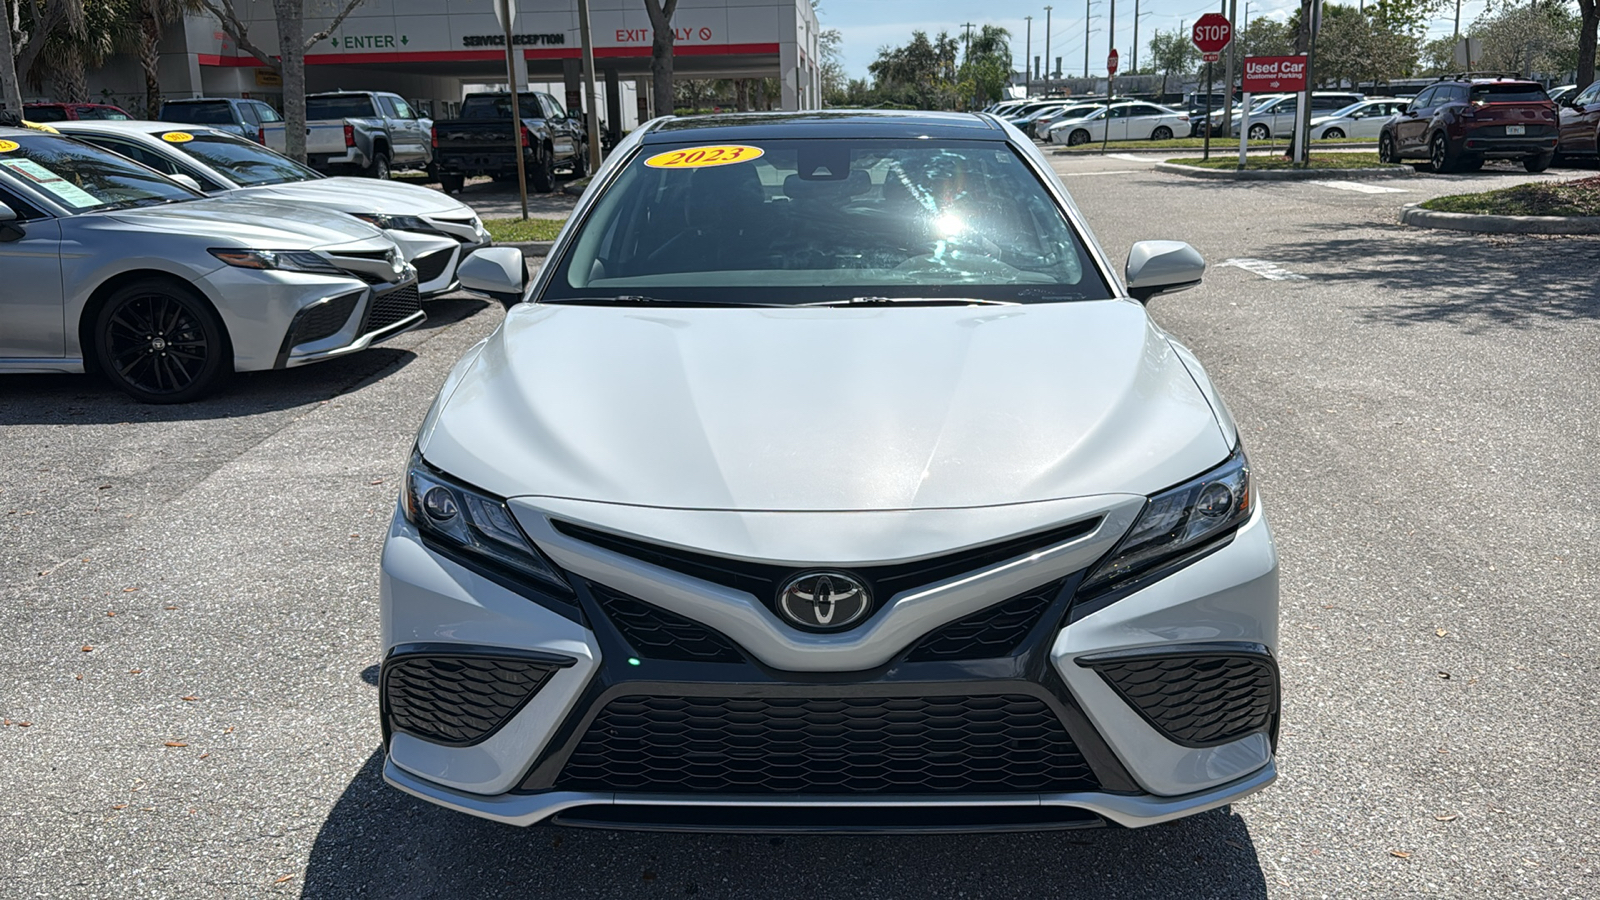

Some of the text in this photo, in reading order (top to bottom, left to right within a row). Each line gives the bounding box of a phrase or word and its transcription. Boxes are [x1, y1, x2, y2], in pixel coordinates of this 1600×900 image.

[616, 29, 648, 42] EXIT
[1195, 25, 1229, 42] STOP
[344, 35, 395, 49] ENTER
[463, 35, 506, 47] SERVICE
[1246, 62, 1304, 73] Used Car
[663, 147, 744, 165] 2023
